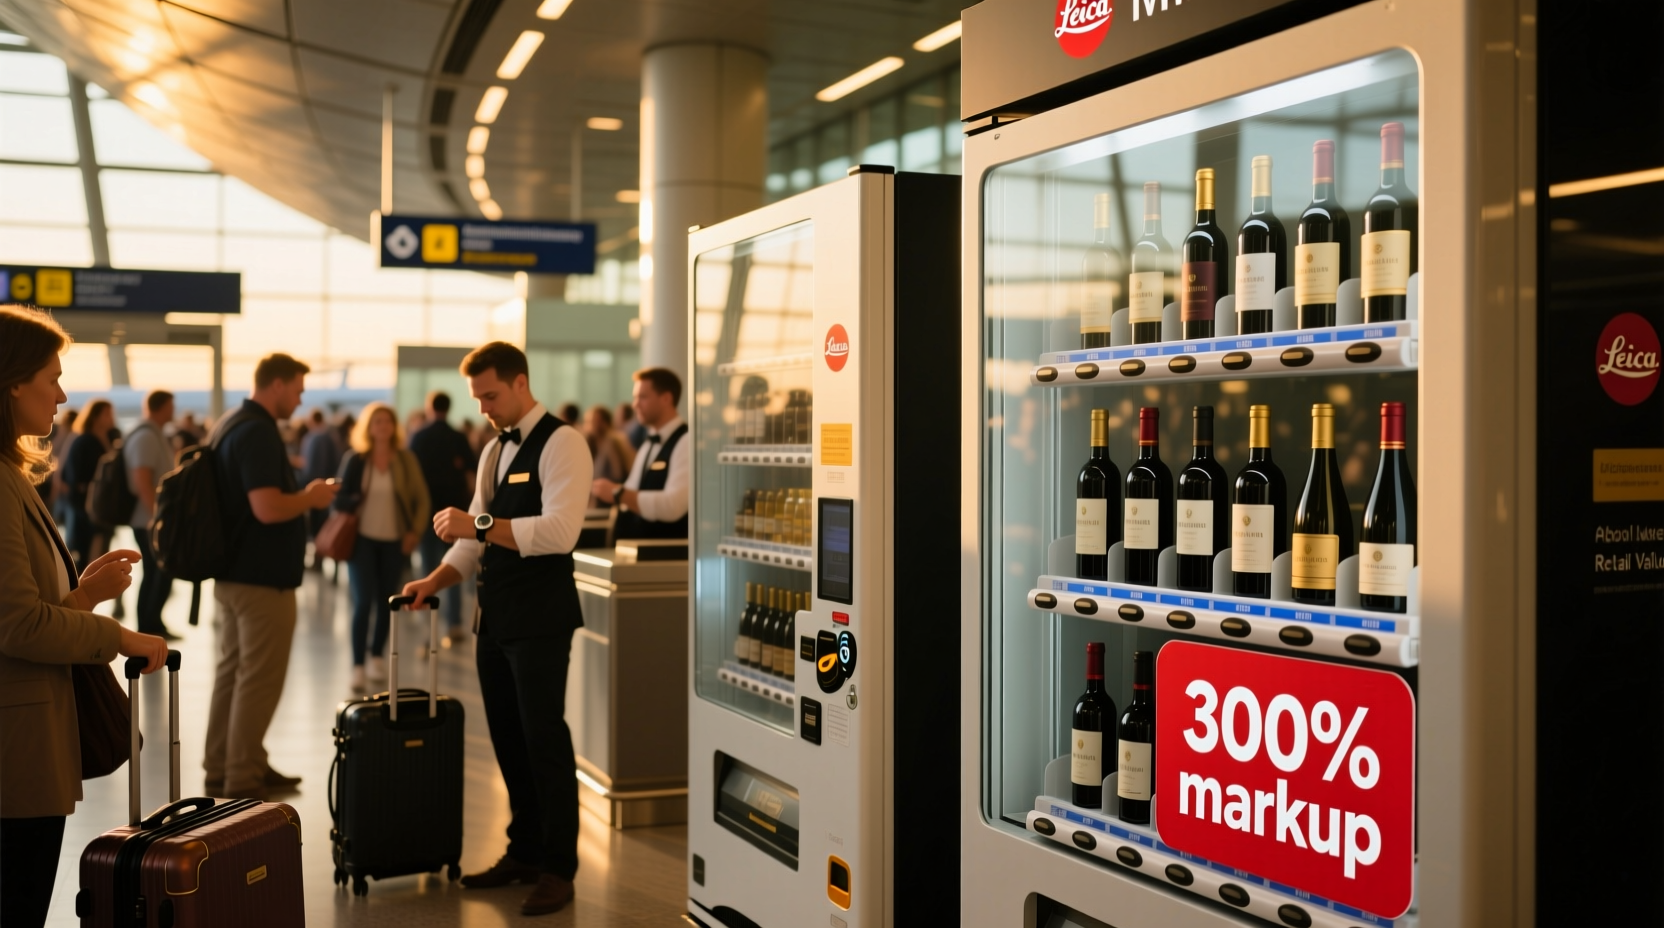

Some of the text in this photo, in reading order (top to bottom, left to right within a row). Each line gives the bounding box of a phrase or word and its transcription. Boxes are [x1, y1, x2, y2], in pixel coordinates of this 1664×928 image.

[1598, 335, 1660, 379] Leica
[1182, 679, 1381, 790] 300%
[1178, 771, 1382, 879] markup
